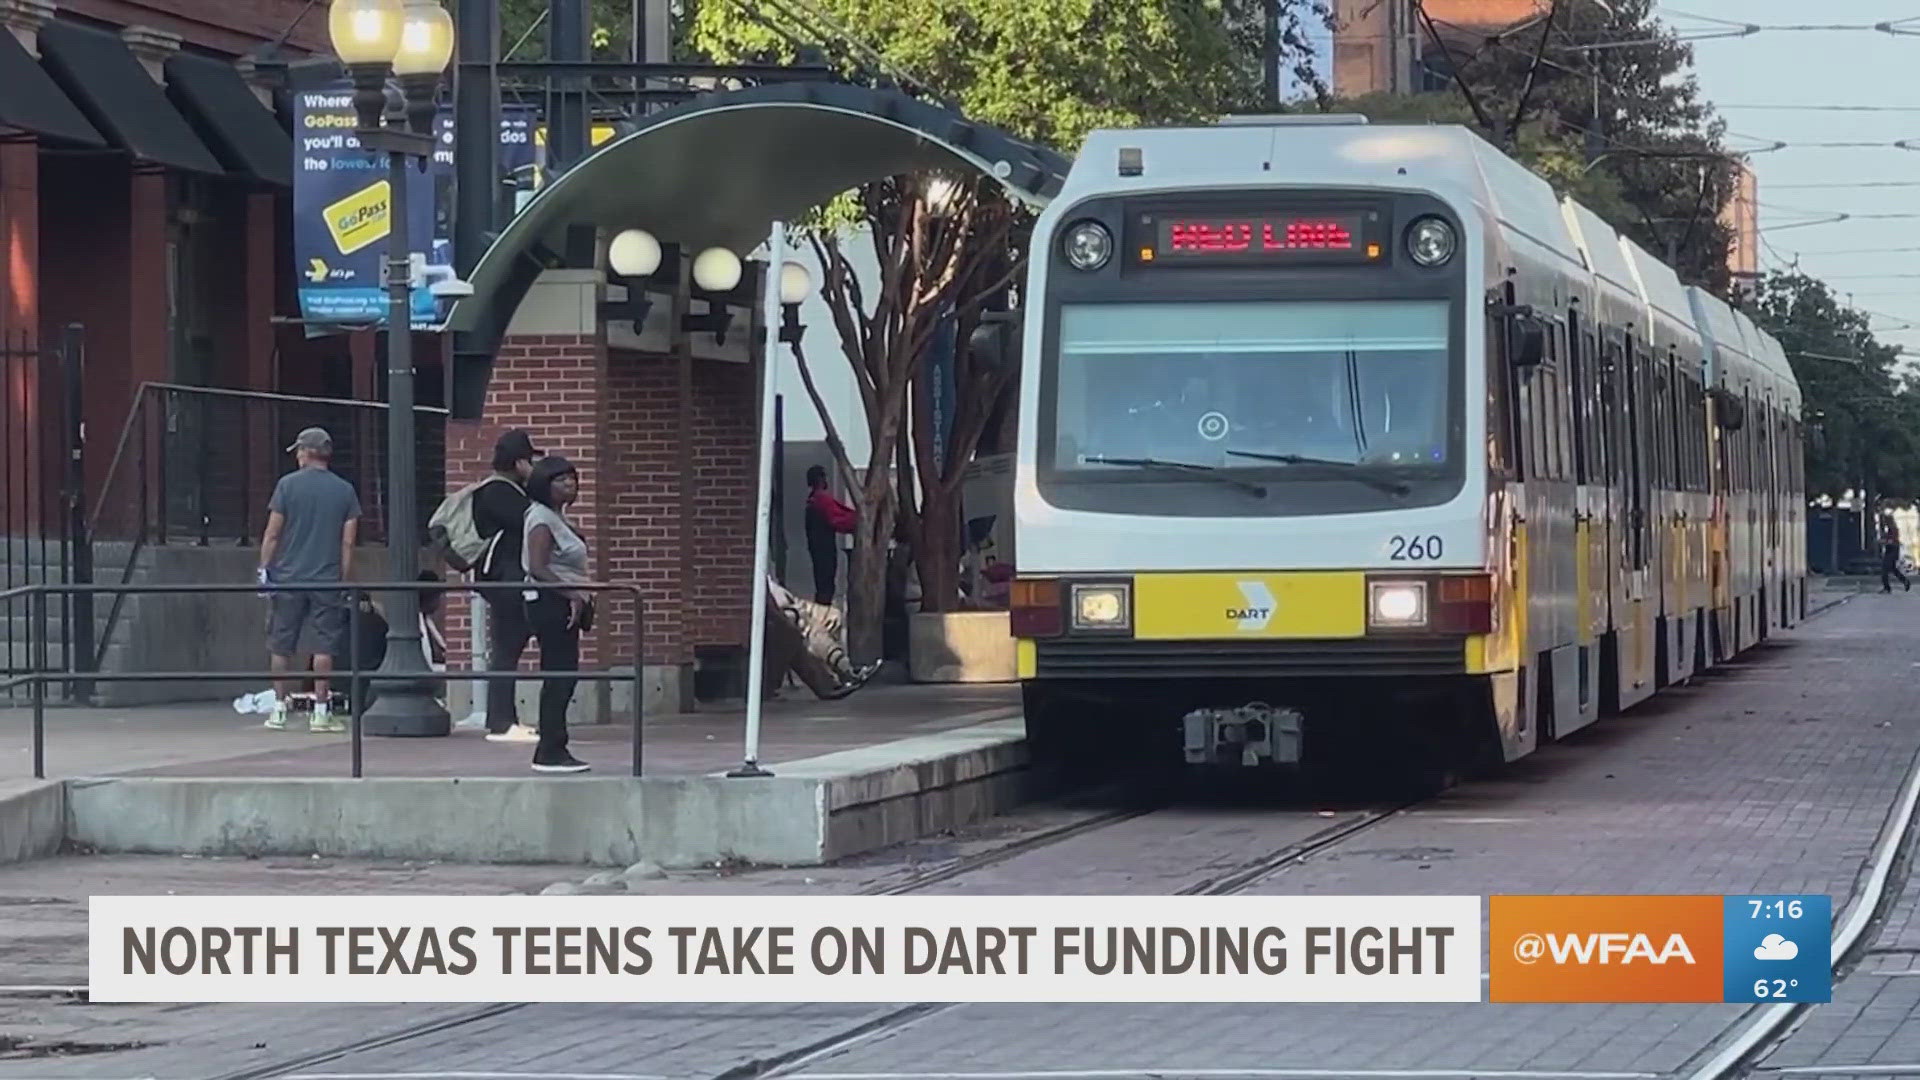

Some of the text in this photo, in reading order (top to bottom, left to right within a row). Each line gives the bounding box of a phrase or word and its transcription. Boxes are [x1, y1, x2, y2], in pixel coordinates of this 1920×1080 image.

[304, 115, 358, 128] GoPass
[304, 135, 343, 152] you'll
[304, 157, 328, 171] the
[338, 199, 387, 231] GoPass
[1390, 535, 1443, 561] 260
[1226, 608, 1270, 620] DART
